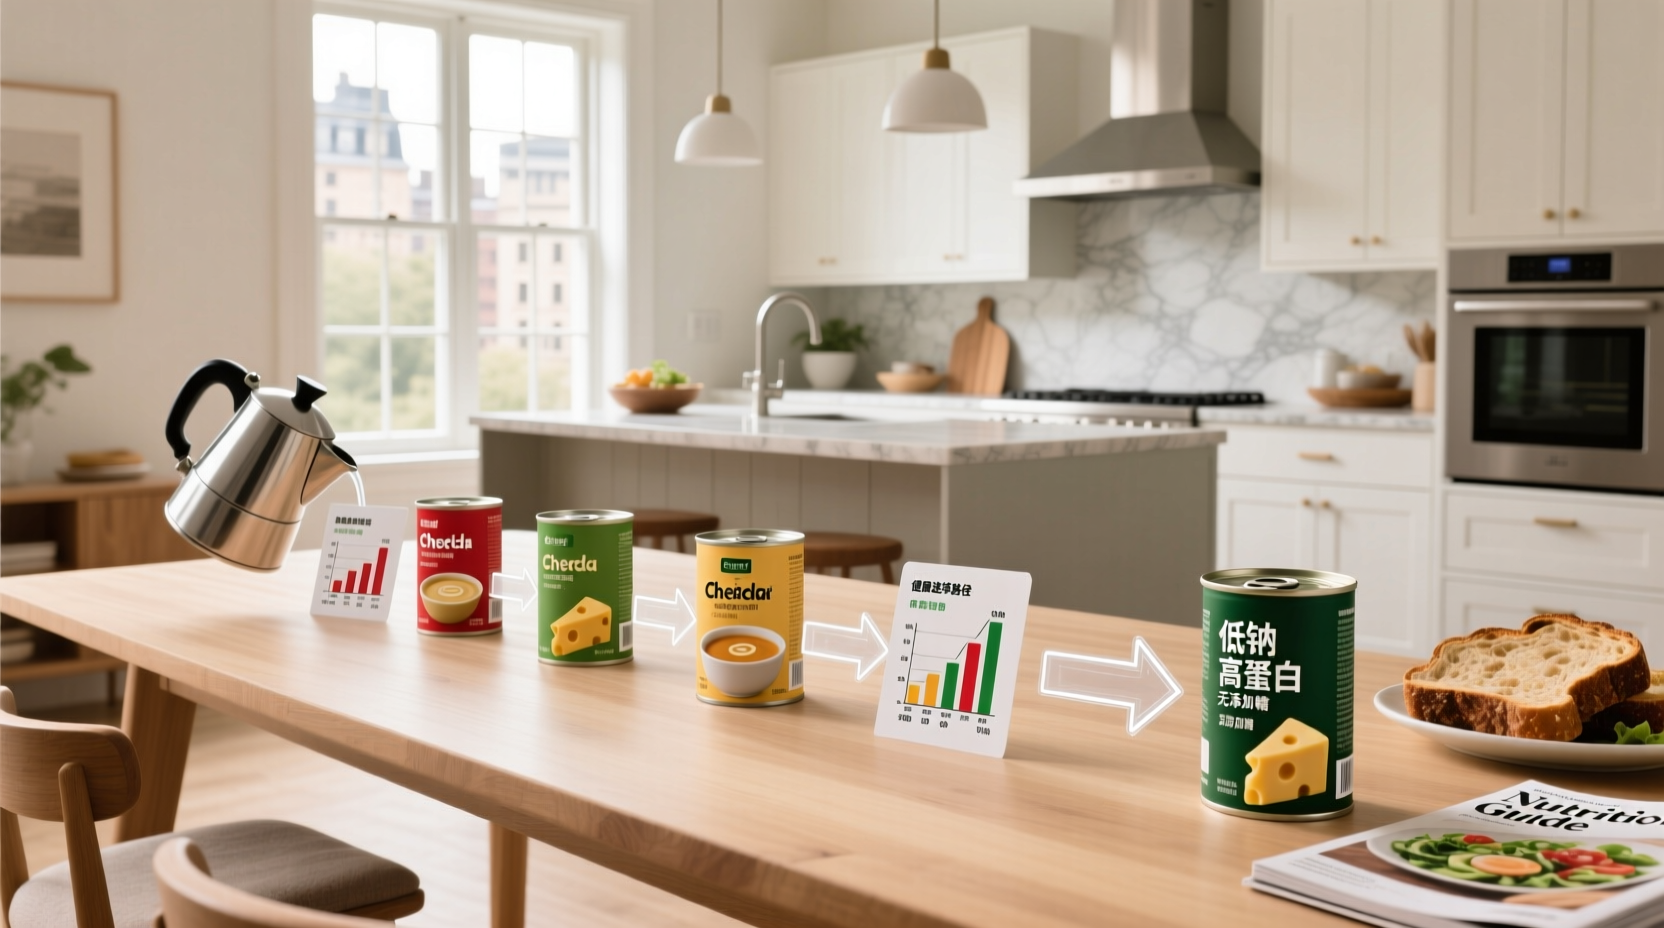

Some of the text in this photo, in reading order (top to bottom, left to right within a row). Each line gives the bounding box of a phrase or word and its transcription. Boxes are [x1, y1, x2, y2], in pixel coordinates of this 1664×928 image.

[1218, 619, 1277, 657] 低钠
[1218, 656, 1301, 693] 高蛋白
[1474, 802, 1589, 832] Guide
